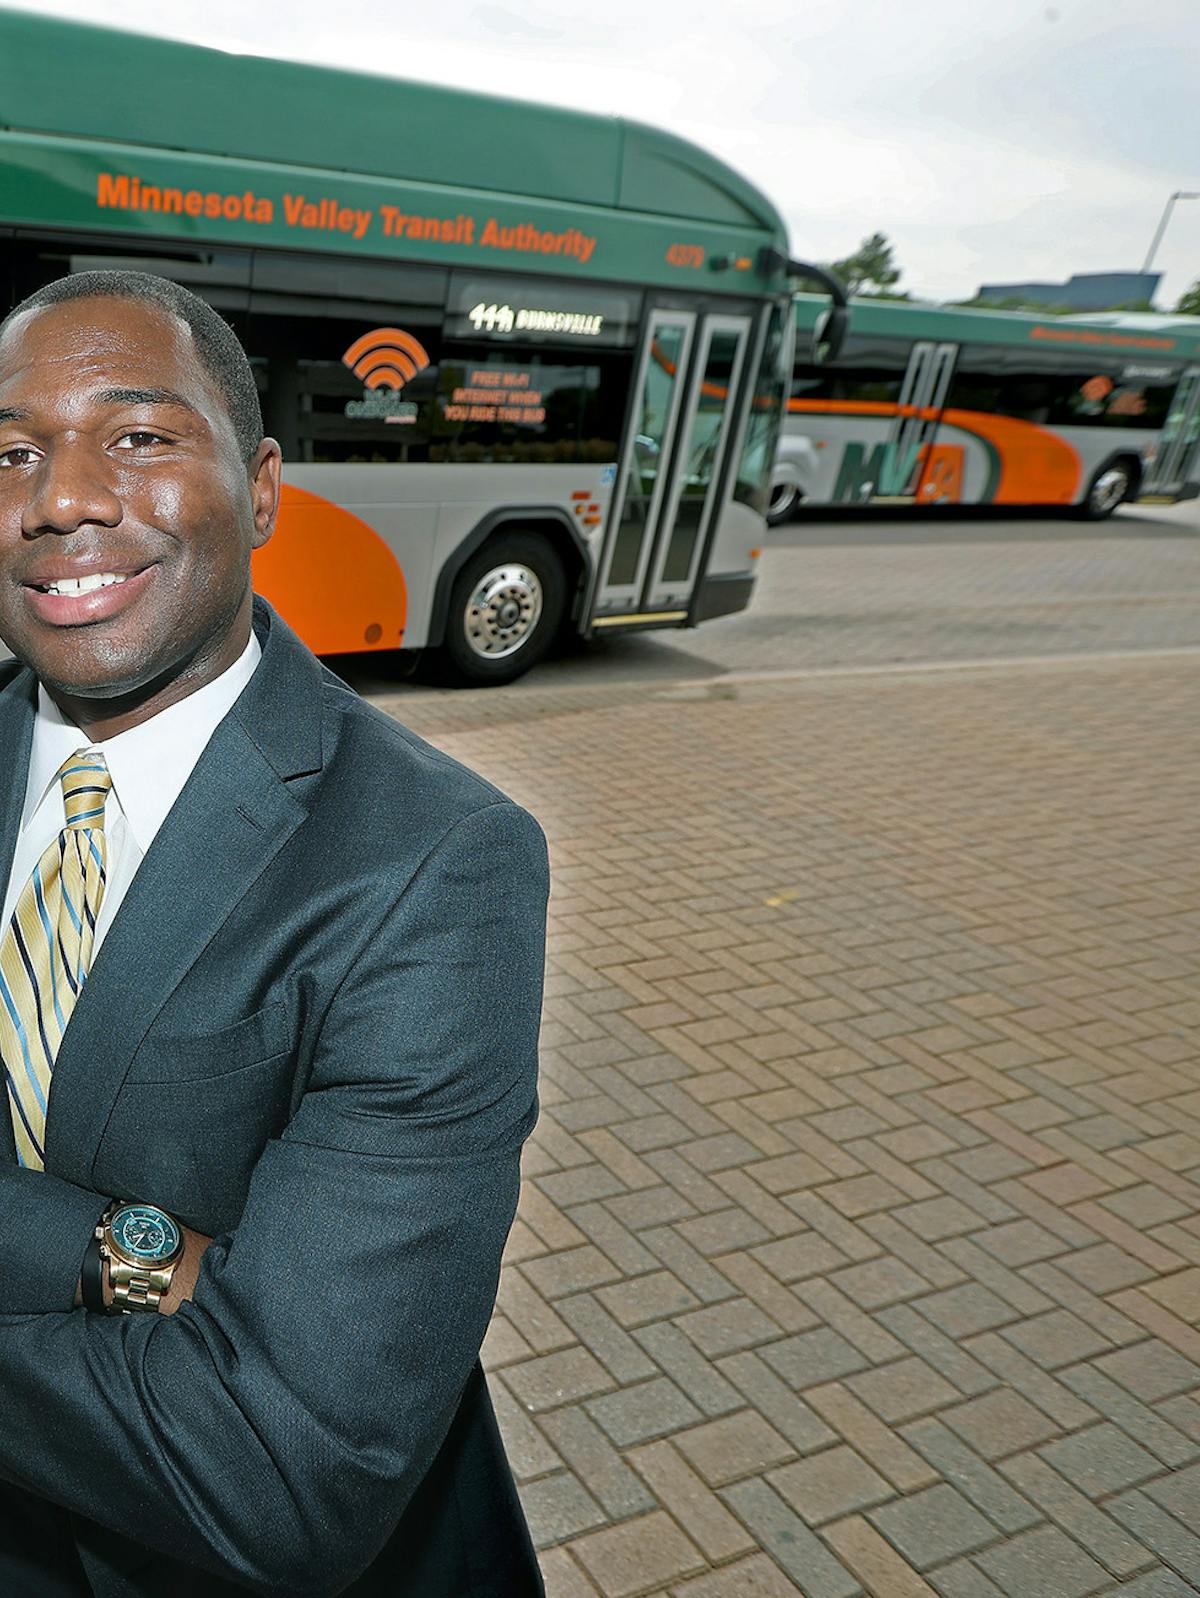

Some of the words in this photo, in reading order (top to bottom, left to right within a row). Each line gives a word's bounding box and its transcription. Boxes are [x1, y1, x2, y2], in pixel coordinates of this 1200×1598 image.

[97, 172, 274, 225] Minnesota
[283, 193, 373, 240] Valley
[380, 204, 475, 246] Transit
[479, 217, 597, 264] Authority
[516, 309, 603, 335] BURNSVILLE
